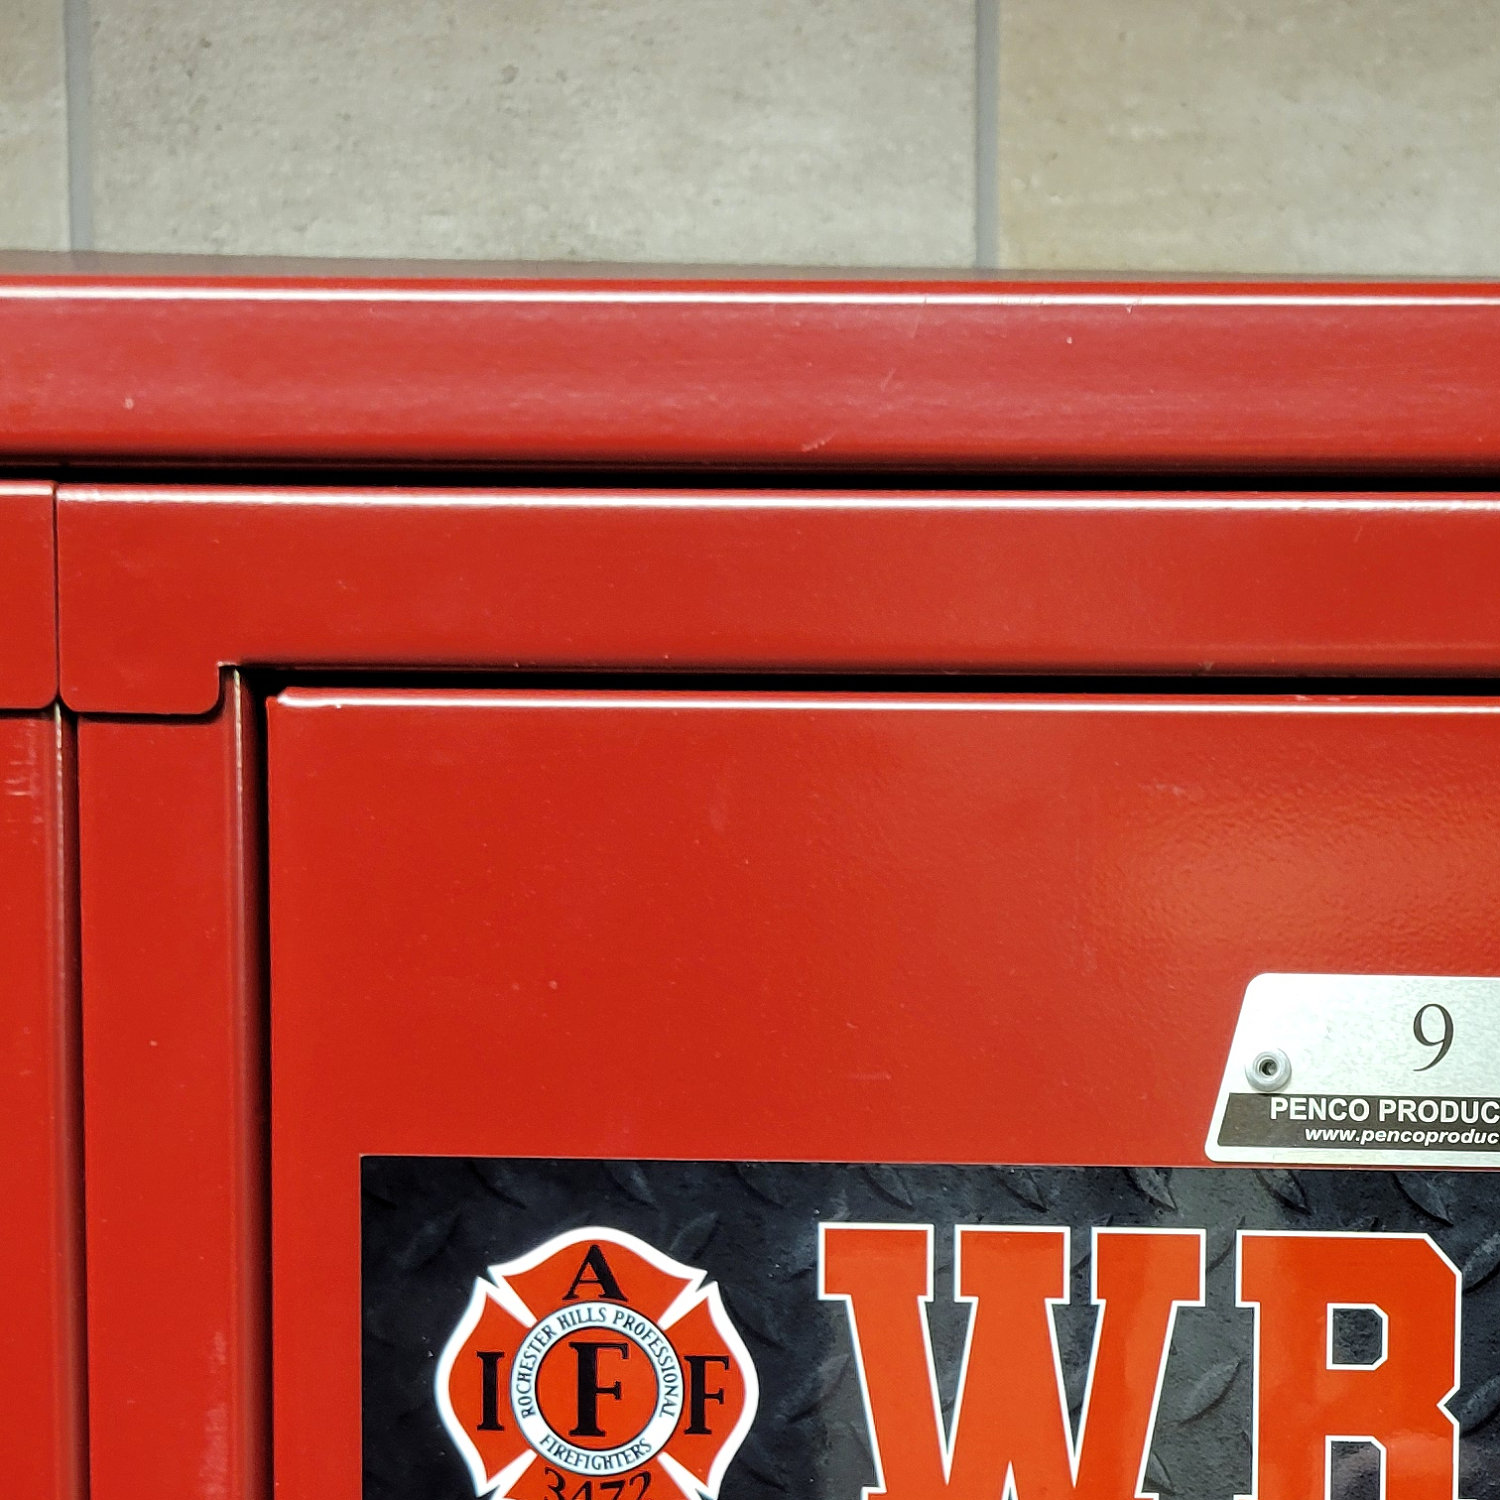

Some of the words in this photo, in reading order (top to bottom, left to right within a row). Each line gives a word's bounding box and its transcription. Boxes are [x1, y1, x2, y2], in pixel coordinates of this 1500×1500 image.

[1412, 1003, 1454, 1073] 9
[1270, 1096, 1370, 1122] PENCO
[562, 1244, 628, 1302] A
[516, 1324, 557, 1420] ROCHESTER
[559, 1306, 608, 1331] HILLS
[613, 1311, 680, 1418] PROFESSIONAL
[569, 1341, 629, 1437] F
[683, 1355, 730, 1435] F
[539, 1433, 653, 1471] FIREFIGHTERS
